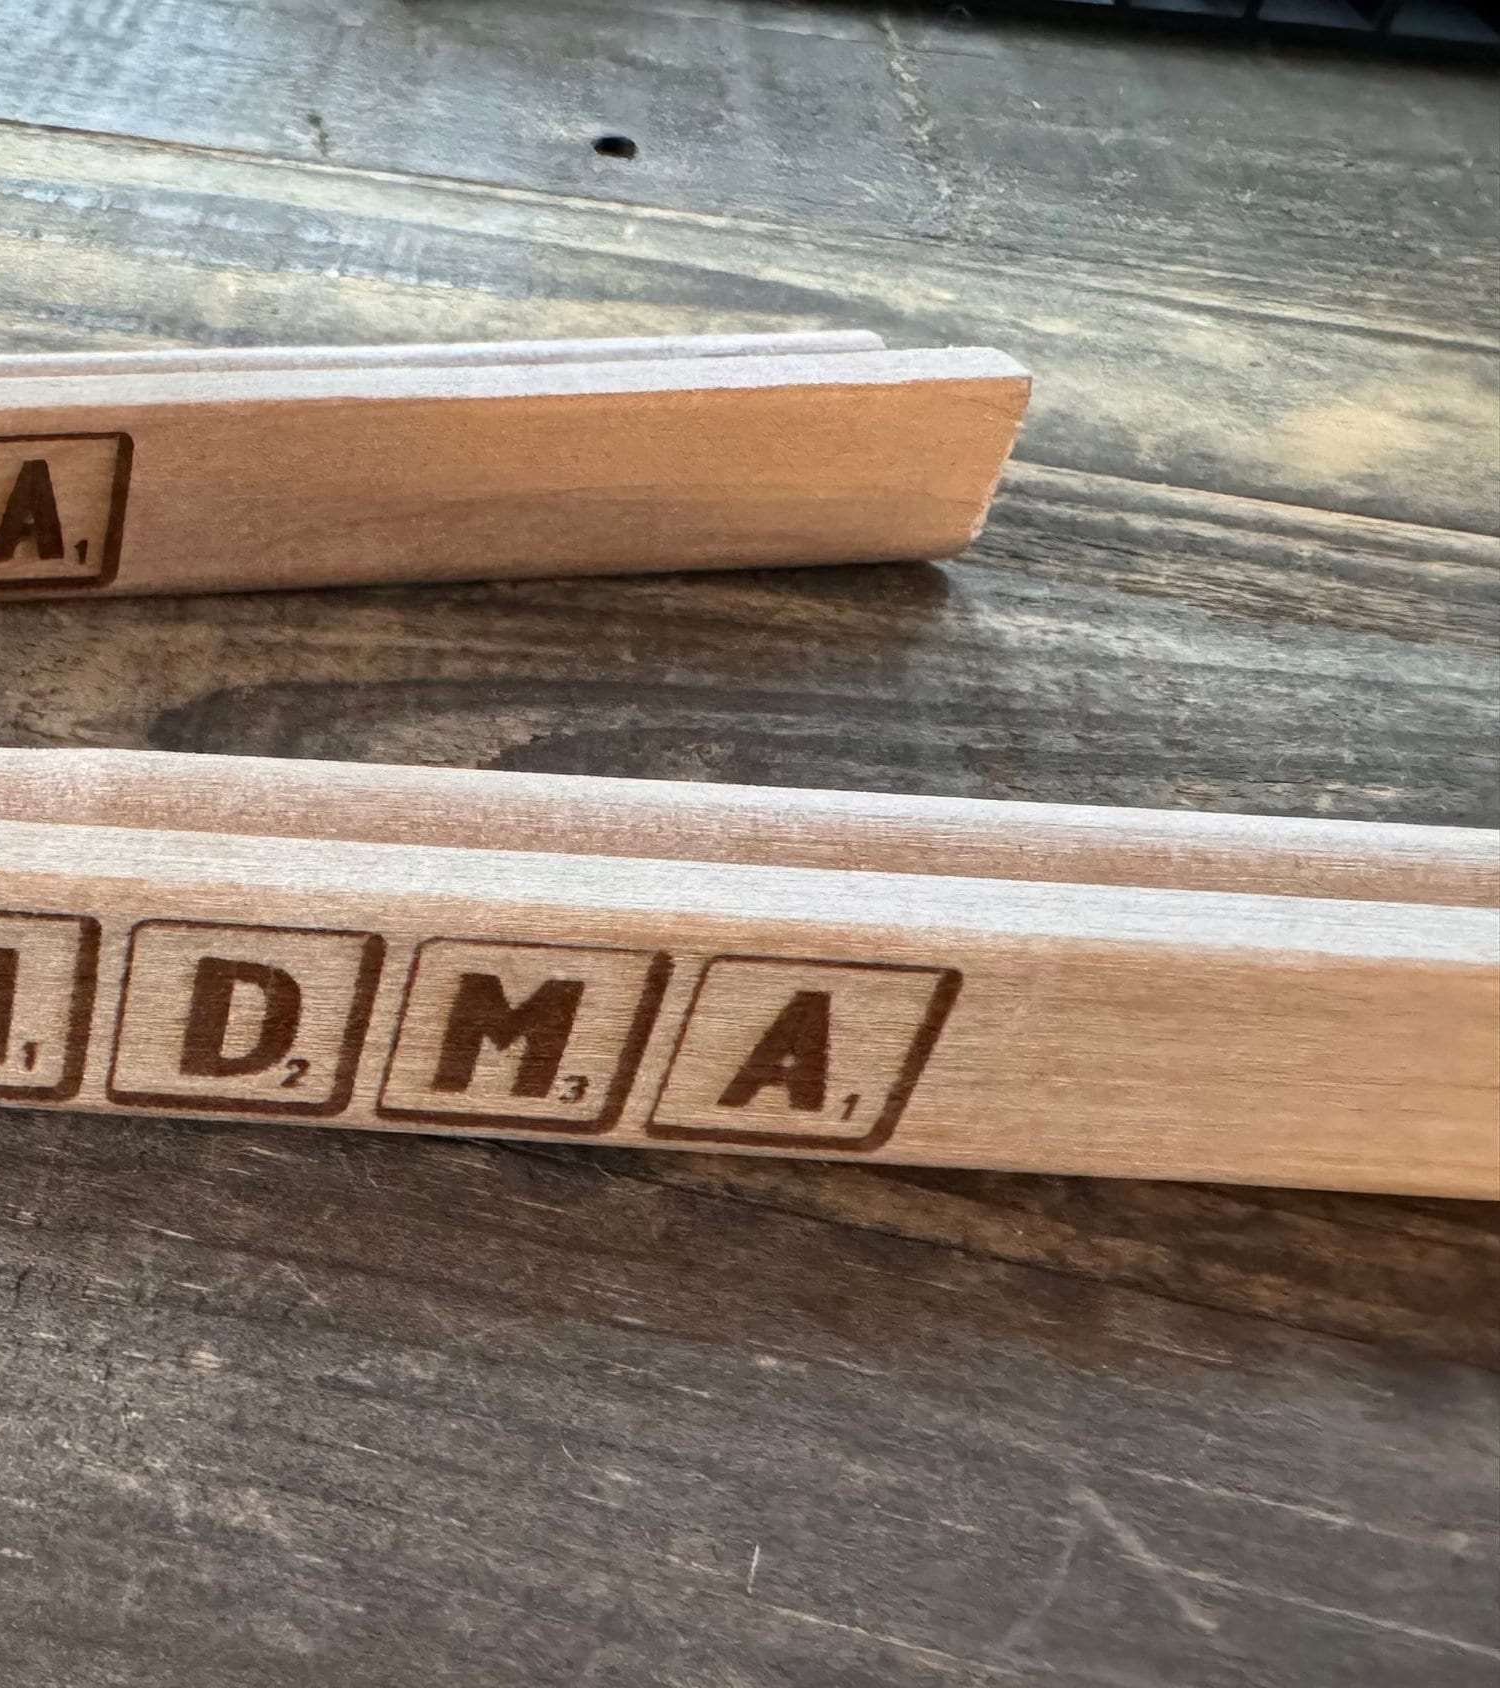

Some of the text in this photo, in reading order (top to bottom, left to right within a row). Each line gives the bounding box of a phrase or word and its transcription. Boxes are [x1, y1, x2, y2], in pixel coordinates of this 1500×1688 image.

[21, 1041, 37, 1072] 1
[281, 1058, 311, 1089] 2
[557, 1074, 590, 1106] 3
[839, 1092, 861, 1121] 1
